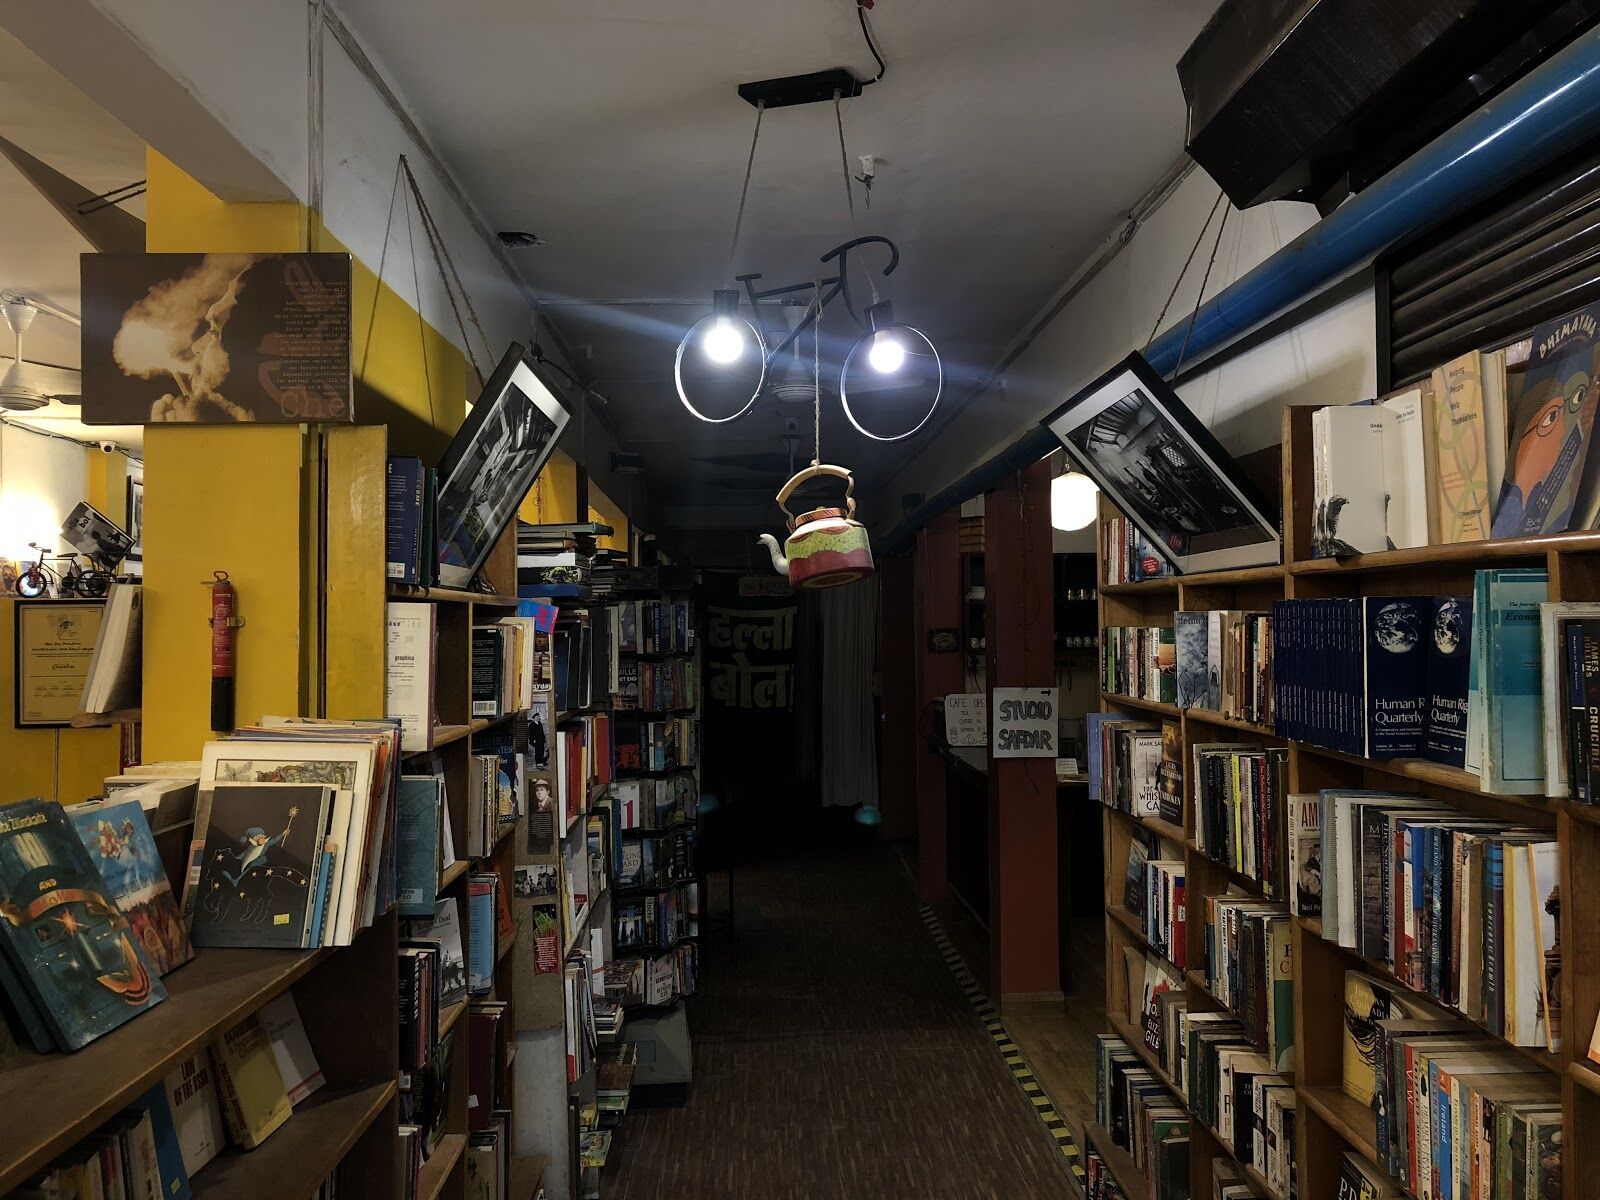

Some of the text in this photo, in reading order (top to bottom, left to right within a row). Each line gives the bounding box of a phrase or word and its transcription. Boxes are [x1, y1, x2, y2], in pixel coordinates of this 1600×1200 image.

[1540, 314, 1597, 359] BHIMAYANA
[1451, 413, 1478, 426] Themselves
[78, 515, 91, 529] bol
[1584, 636, 1593, 677] ROLLINS
[1591, 641, 1599, 672] JAMES
[949, 698, 985, 708] CAFE OPE
[999, 699, 1052, 721] STUDIO
[1375, 698, 1415, 709] Human
[1432, 694, 1456, 710] Human
[1375, 710, 1424, 725] Quarterly
[1431, 708, 1460, 726] Quarterly
[998, 728, 1053, 751] SAFDAR
[1589, 707, 1600, 772] CRUCIBLE
[1487, 955, 1495, 992] Growth
[174, 1087, 182, 1107] OF
[183, 1078, 193, 1101] THE
